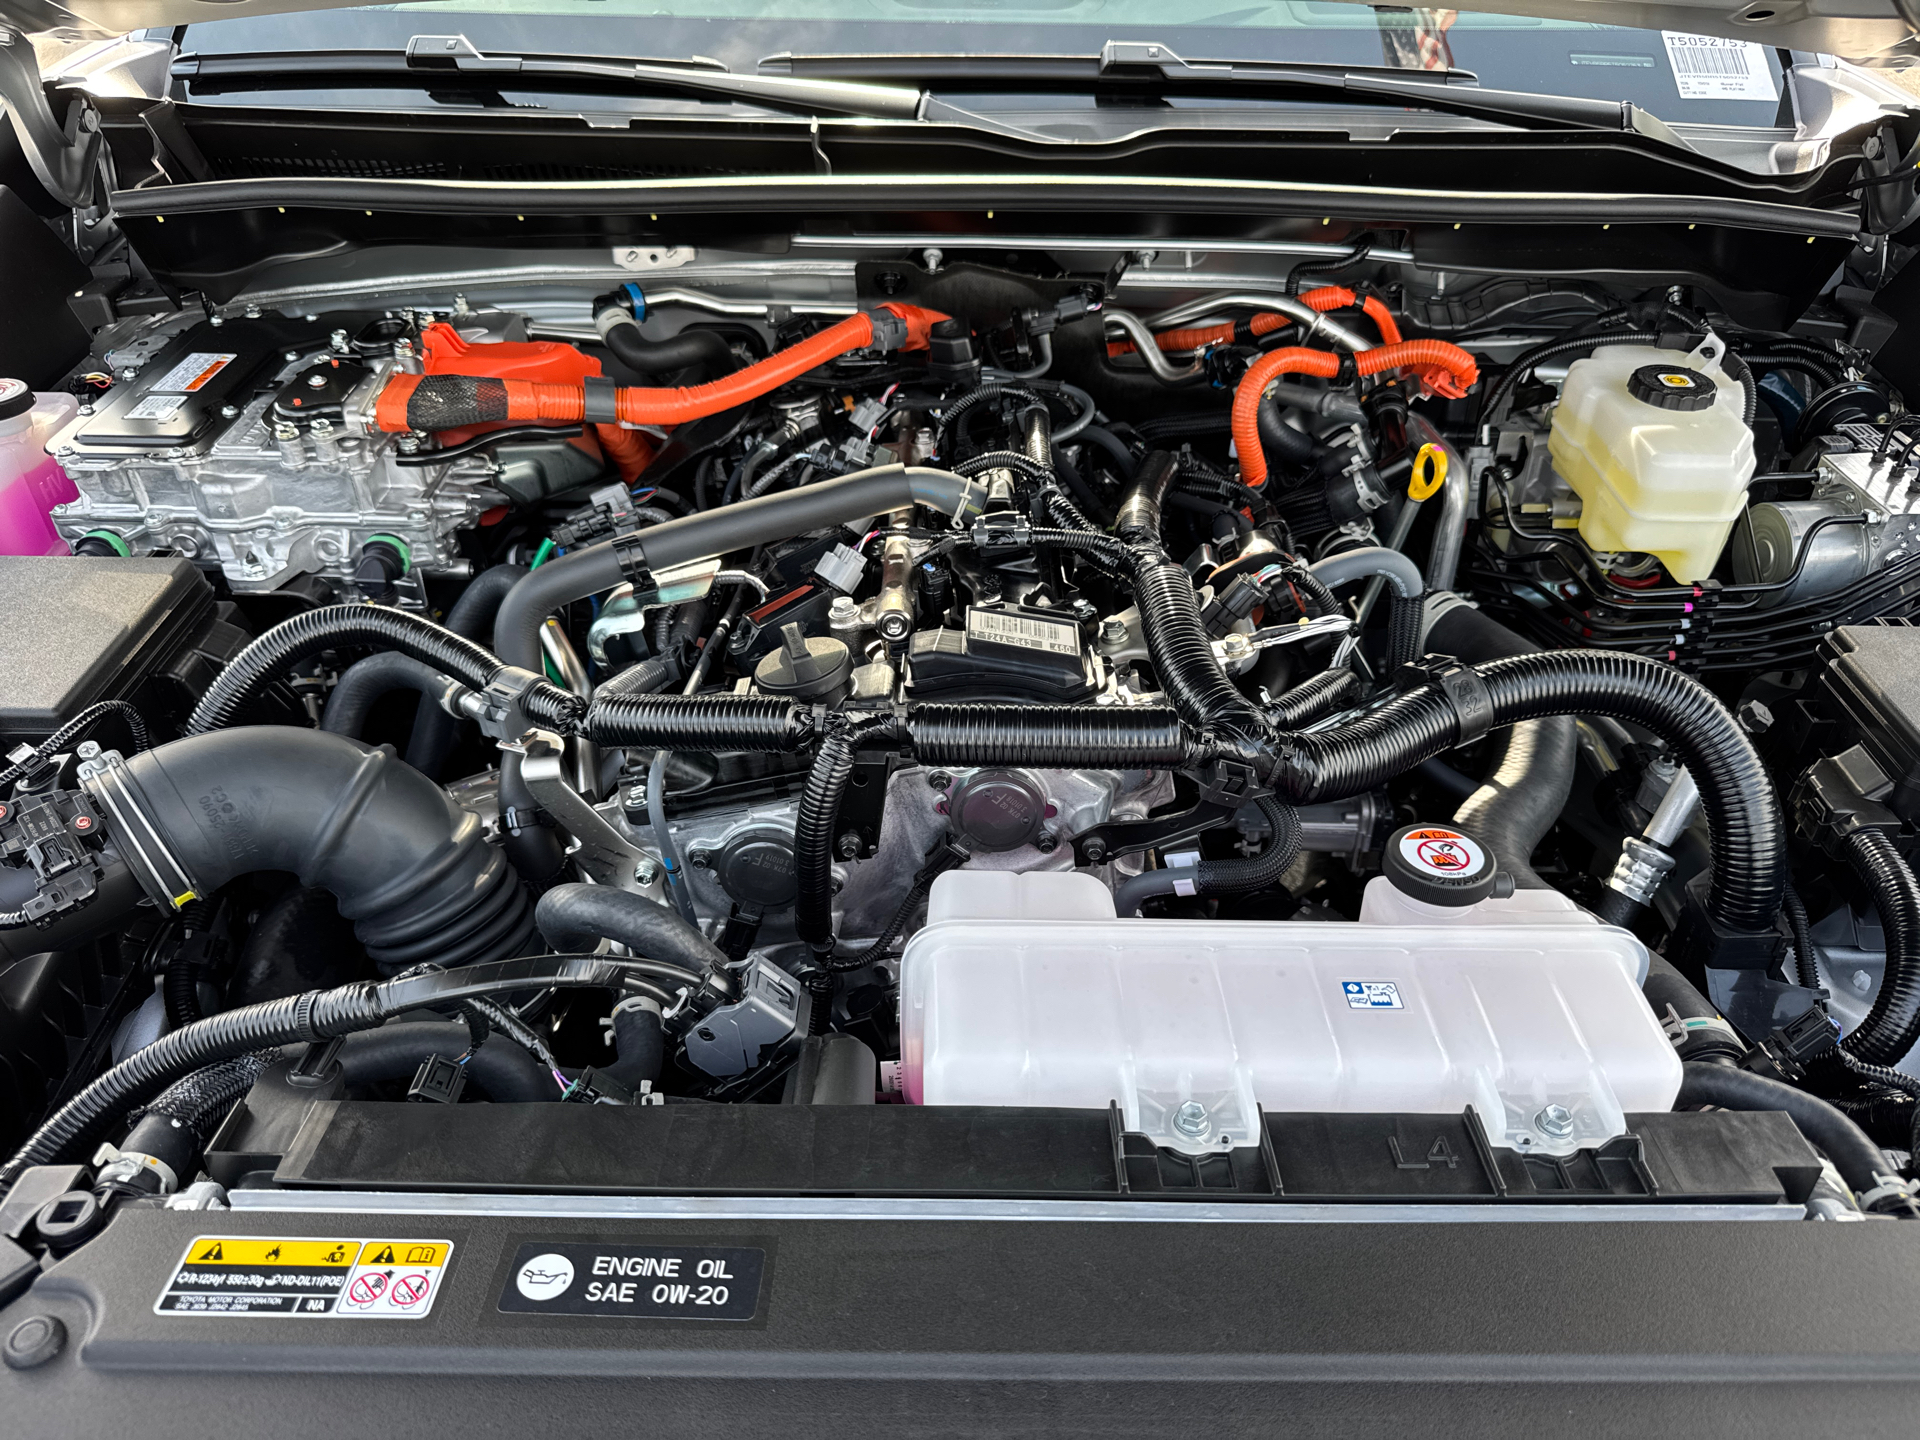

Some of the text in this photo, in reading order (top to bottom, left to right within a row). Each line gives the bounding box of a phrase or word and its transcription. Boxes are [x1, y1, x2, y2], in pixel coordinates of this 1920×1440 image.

[991, 793, 1007, 805] F
[752, 853, 764, 866] F
[1387, 1135, 1459, 1169] L4
[592, 1256, 734, 1279] ENGINE OIL
[207, 1296, 233, 1304] MOTOR
[234, 1296, 283, 1305] CORPORATION
[584, 1282, 729, 1306] SAE 0W-20
[305, 1299, 325, 1311] NA
